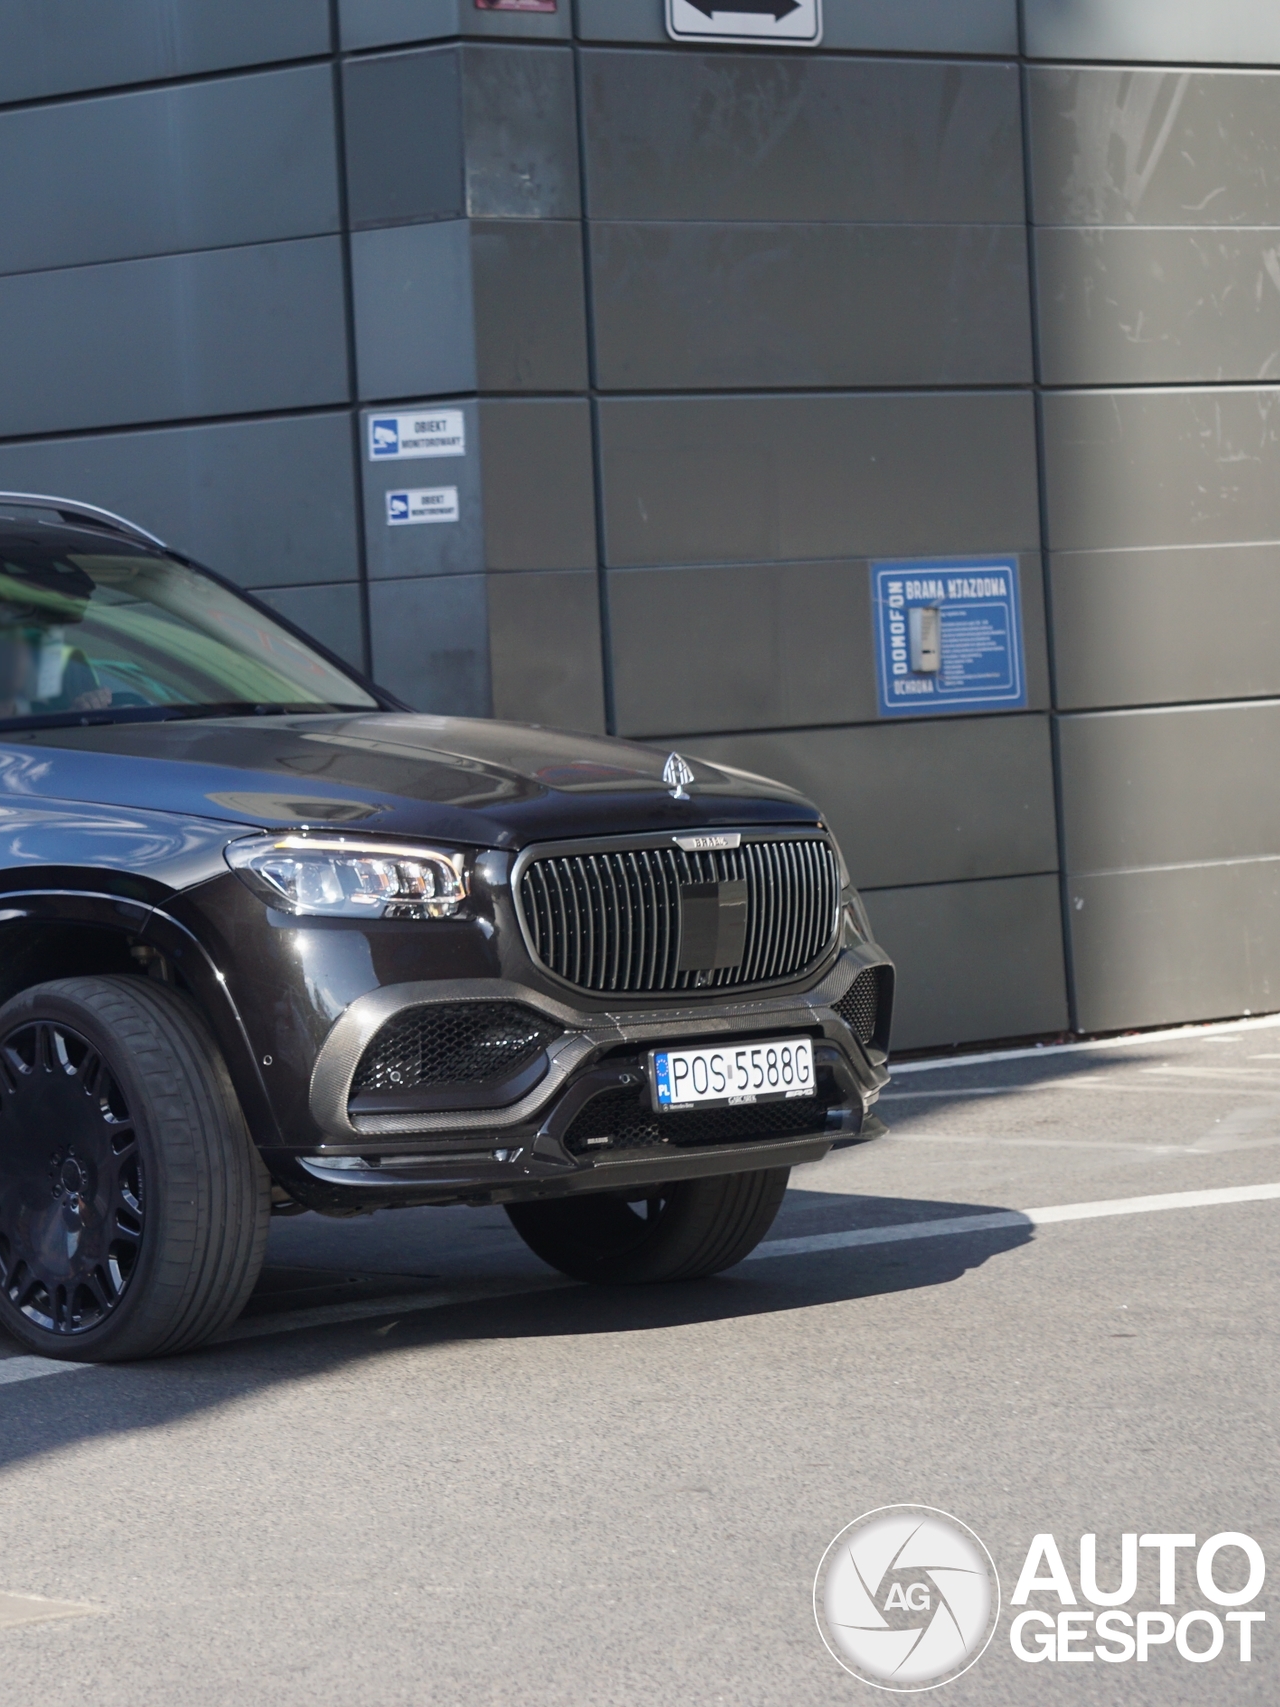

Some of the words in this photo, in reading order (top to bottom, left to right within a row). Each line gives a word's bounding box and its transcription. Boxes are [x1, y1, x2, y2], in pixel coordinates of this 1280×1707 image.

[414, 420, 447, 433] OBIEKT
[401, 437, 461, 449] MONITOROWANY
[906, 579, 945, 600] BRAMA
[947, 577, 1007, 599] WJAZDOWA
[888, 581, 908, 675] DOMOFON
[894, 679, 934, 695] OCHRONA
[672, 1054, 726, 1098] POS
[735, 1045, 810, 1090] 5588G
[658, 1084, 670, 1096] PL
